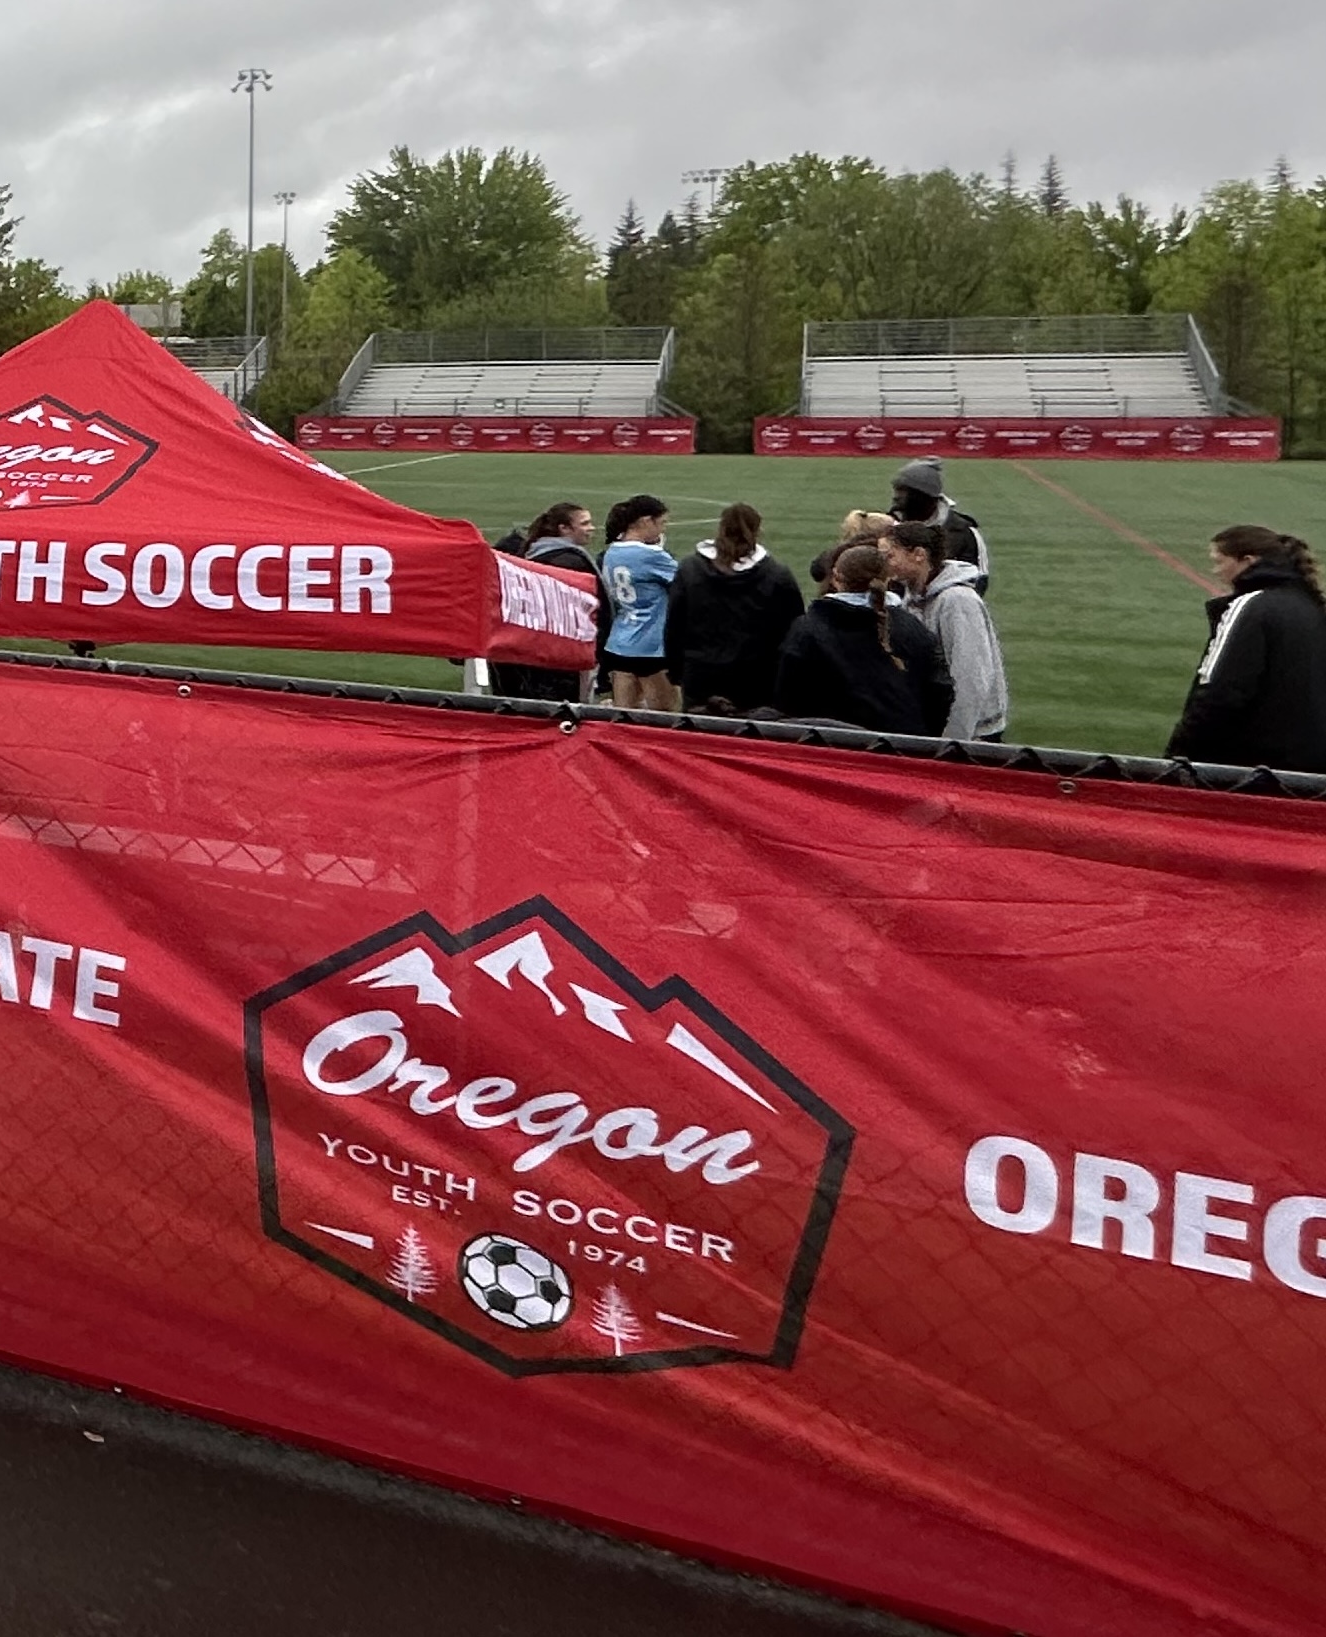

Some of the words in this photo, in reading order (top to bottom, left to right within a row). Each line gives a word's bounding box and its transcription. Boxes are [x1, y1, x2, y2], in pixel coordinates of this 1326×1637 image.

[81, 542, 393, 614] SOCCER
[301, 1010, 760, 1185] Oregon
[318, 1133, 476, 1201] YOUTH
[512, 1190, 735, 1263] SOCCER
[391, 1184, 462, 1215] EST.
[567, 1240, 646, 1273] 1974
[964, 1135, 1326, 1299] OREG
